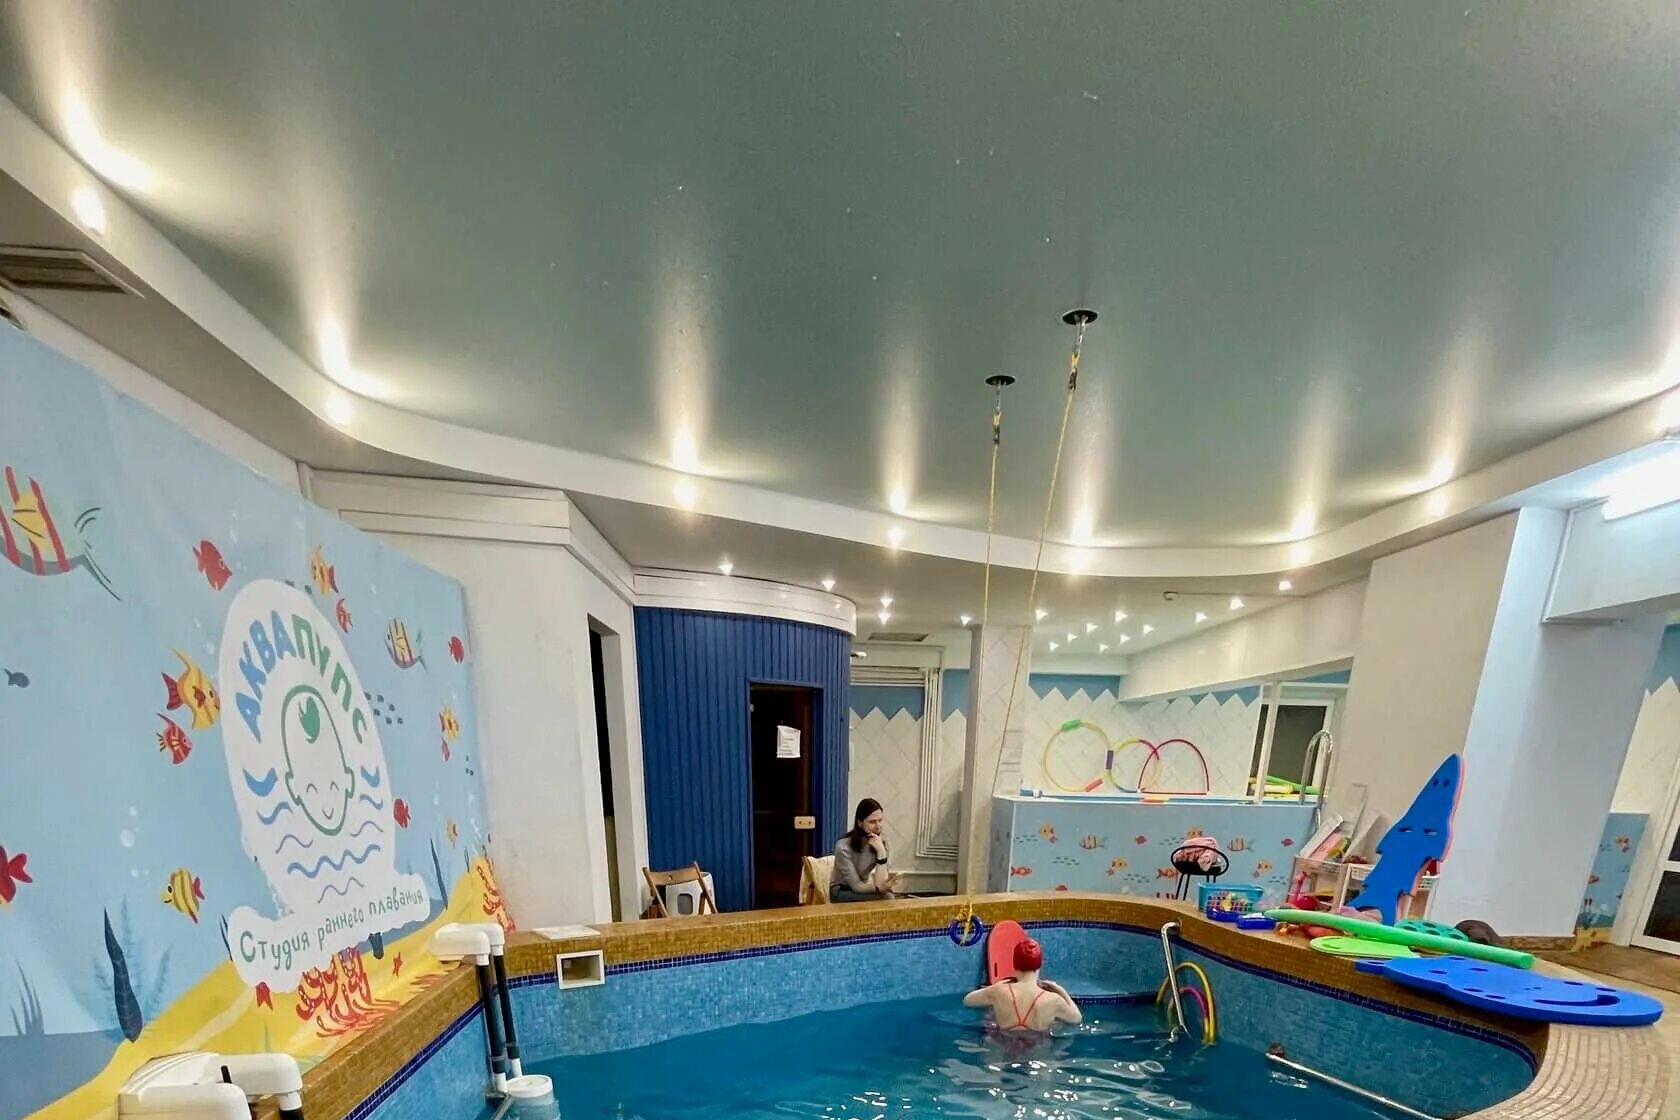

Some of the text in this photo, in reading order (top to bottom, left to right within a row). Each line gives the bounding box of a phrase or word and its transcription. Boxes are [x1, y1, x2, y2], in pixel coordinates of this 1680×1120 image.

[235, 610, 368, 745] АКВАПУПС
[239, 887, 424, 971] Студия раннего плавания
